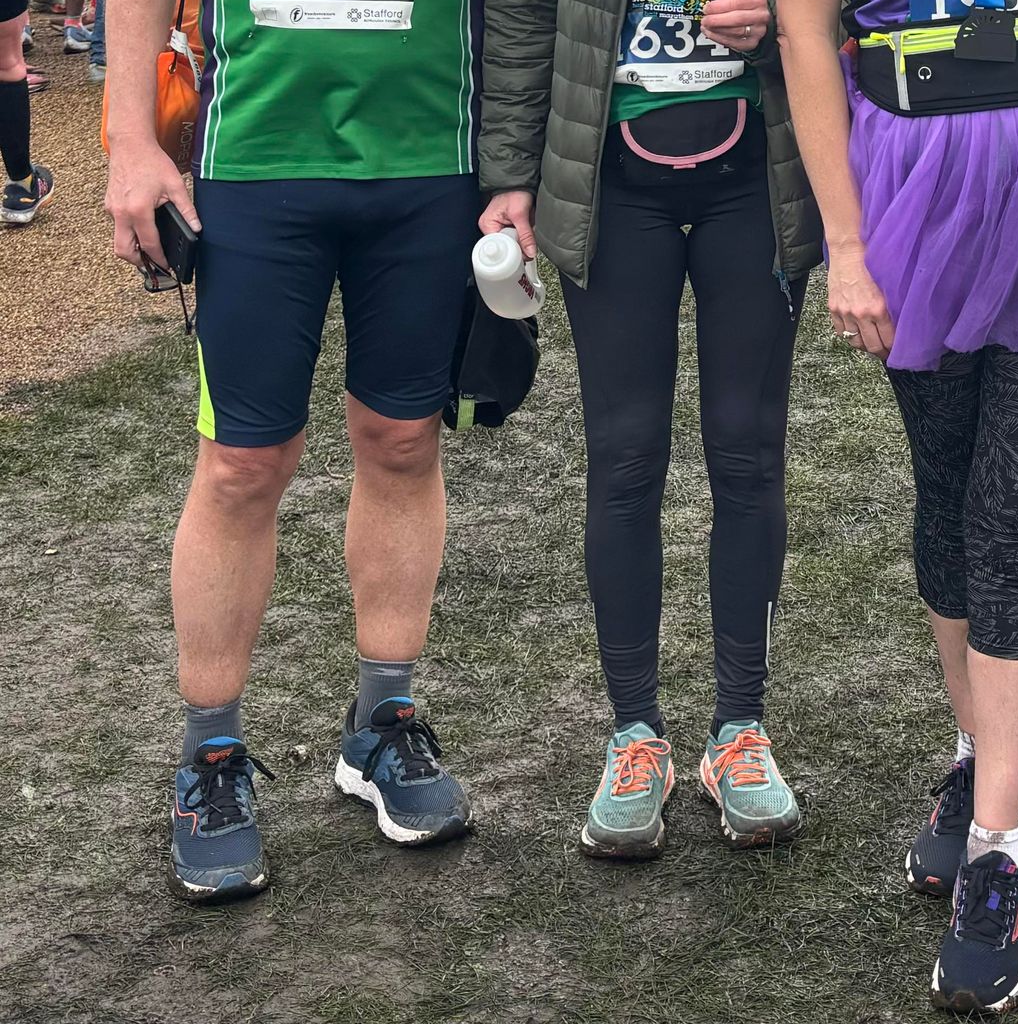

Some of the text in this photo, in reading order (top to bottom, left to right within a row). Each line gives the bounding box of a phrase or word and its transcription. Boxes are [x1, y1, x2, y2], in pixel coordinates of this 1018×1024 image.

[363, 8, 403, 19] Stafford
[644, 4, 684, 13] stafford
[694, 69, 733, 79] Stafford
